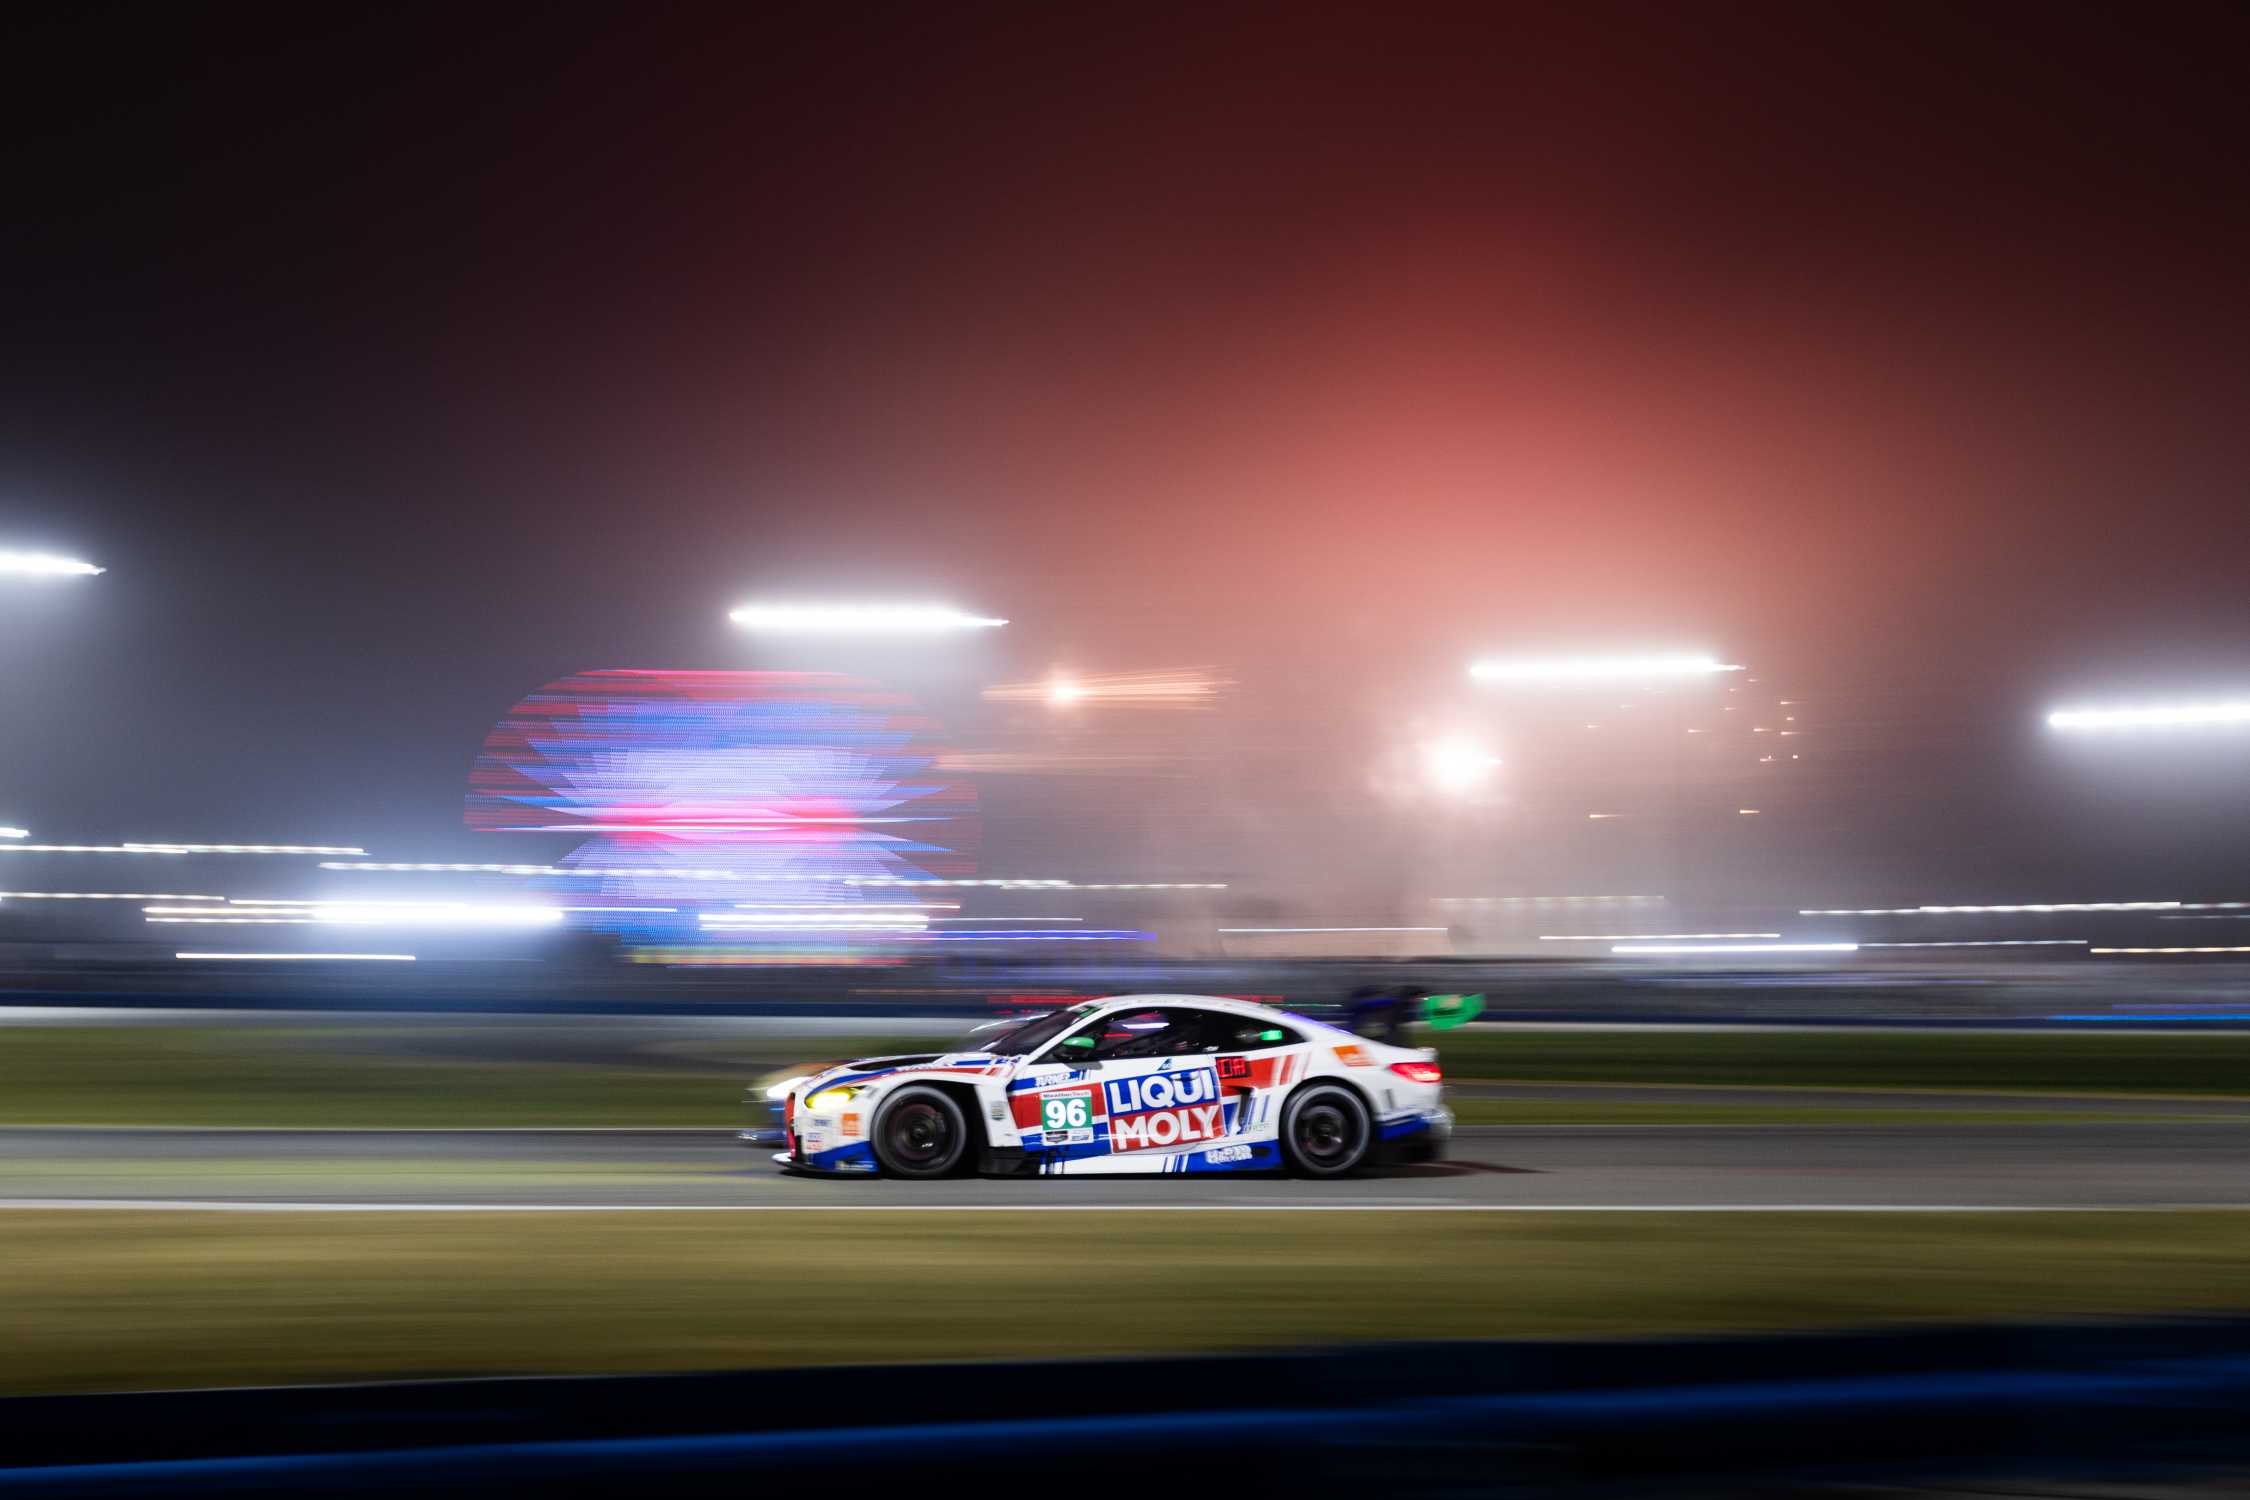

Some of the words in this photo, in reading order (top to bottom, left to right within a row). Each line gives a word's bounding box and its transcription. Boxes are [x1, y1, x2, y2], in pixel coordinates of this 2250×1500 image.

[1109, 1069, 1215, 1113] LIQUI
[1045, 1098, 1087, 1129] 96
[1114, 1104, 1220, 1150] MOLY
